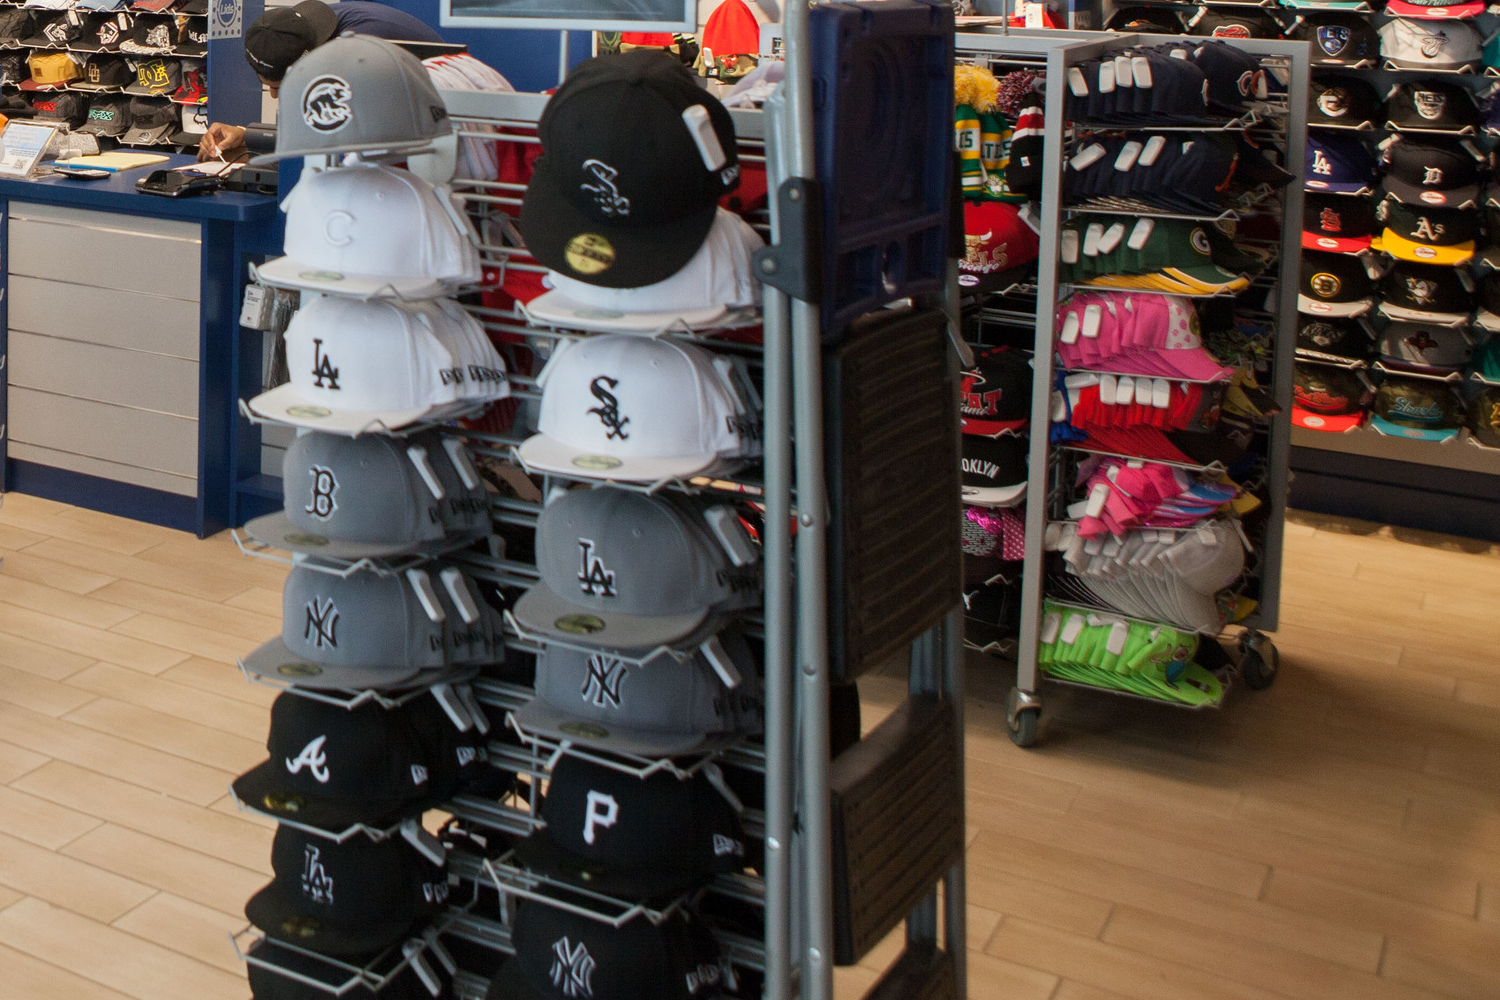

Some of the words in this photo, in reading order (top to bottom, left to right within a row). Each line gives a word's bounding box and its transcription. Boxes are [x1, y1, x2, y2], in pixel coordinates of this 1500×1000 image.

[220, 5, 235, 15] Lids
[313, 338, 341, 390] LA
[304, 465, 340, 522] B
[962, 458, 999, 479] OKLYN
[578, 537, 617, 597] LA
[286, 734, 331, 784] A
[582, 790, 619, 844] P
